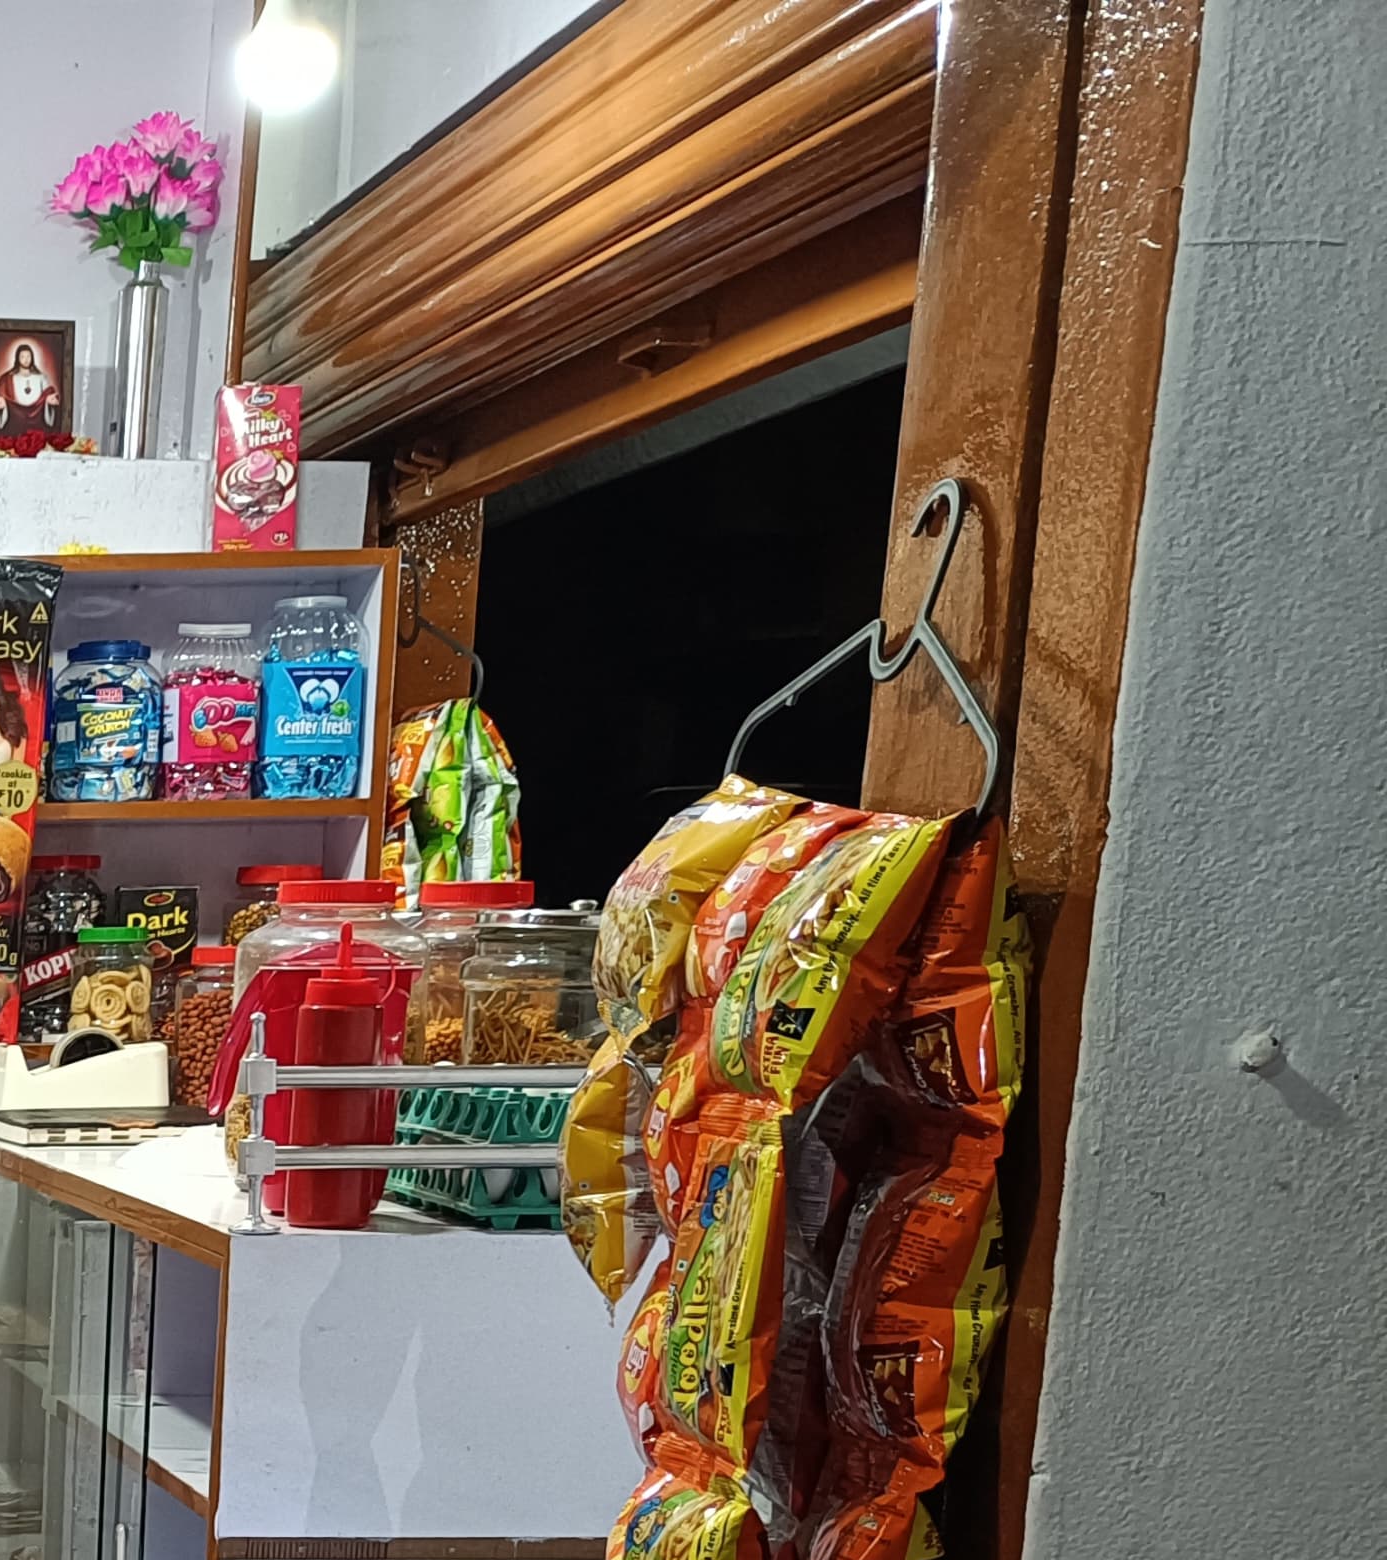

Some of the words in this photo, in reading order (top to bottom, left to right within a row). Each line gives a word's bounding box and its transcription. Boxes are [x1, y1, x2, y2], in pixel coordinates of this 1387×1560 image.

[247, 428, 293, 448] Heart
[80, 707, 135, 727] COCONUT
[277, 717, 317, 737] Center
[321, 717, 353, 737] fresh
[127, 906, 188, 929] Dark
